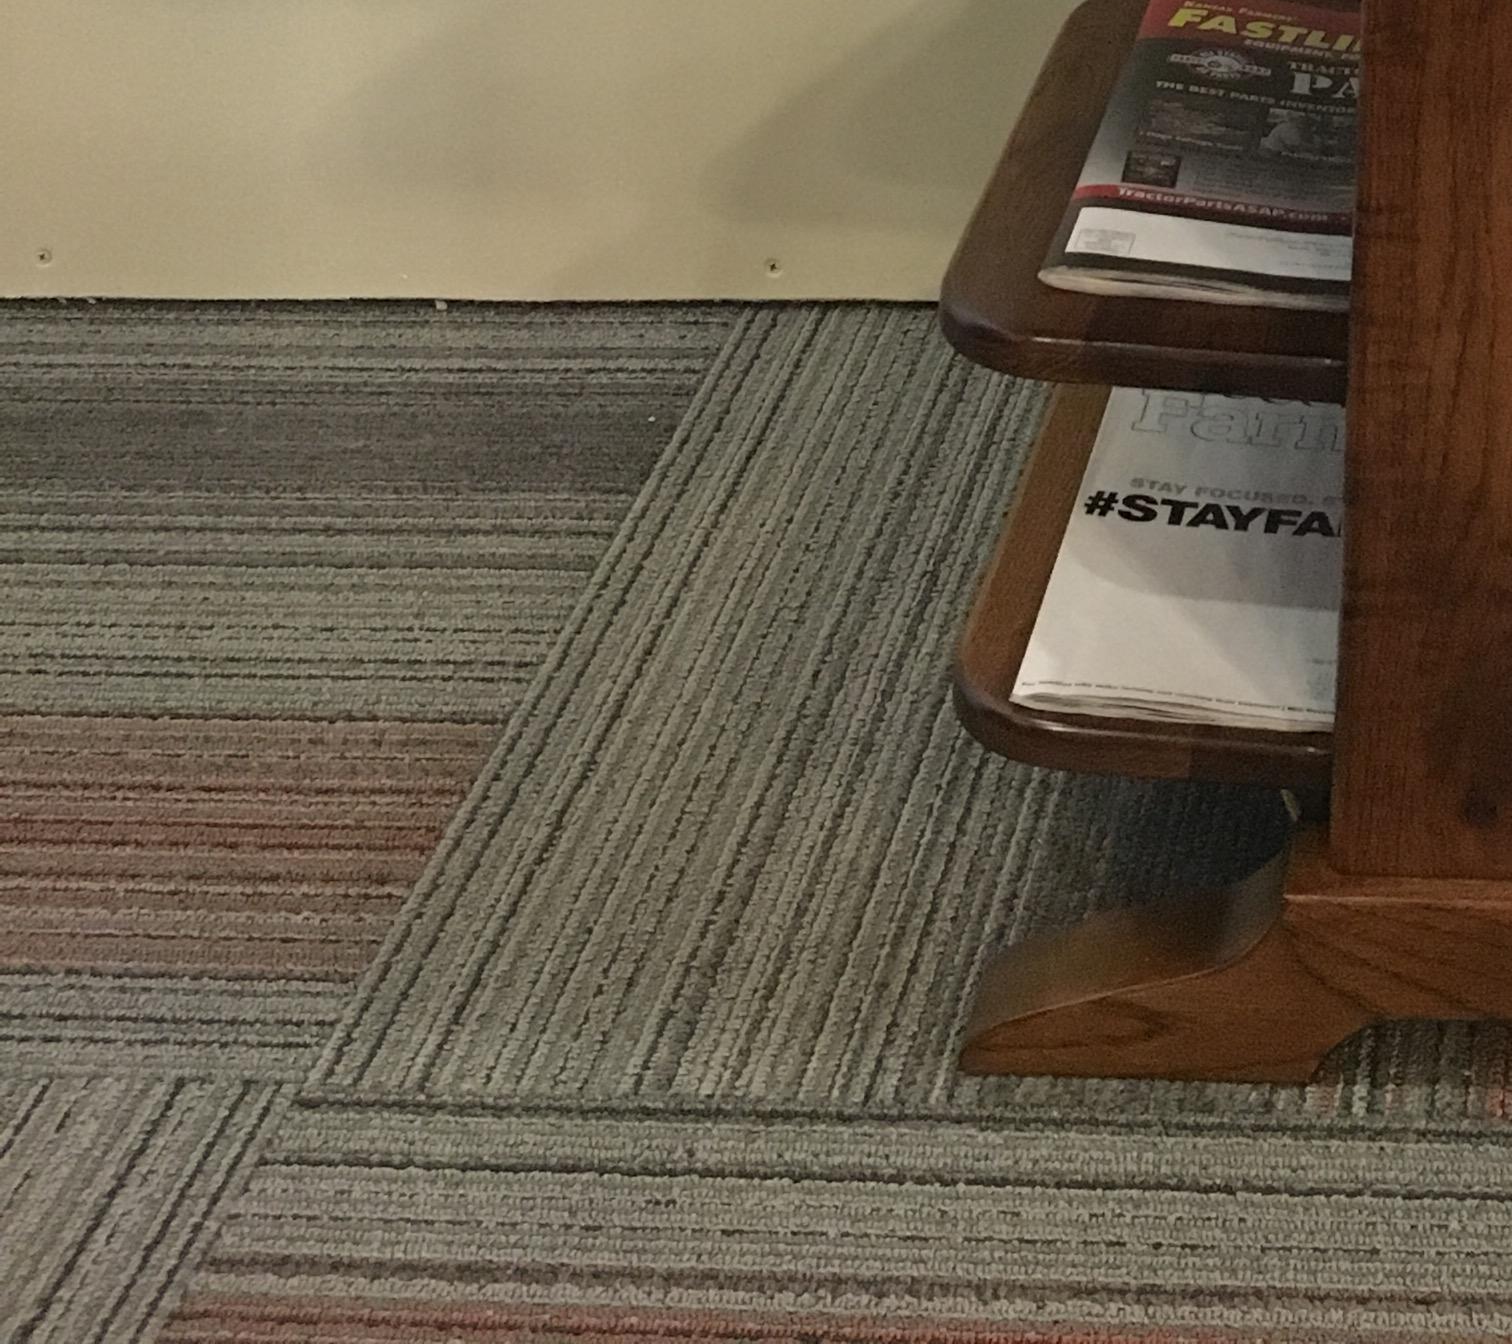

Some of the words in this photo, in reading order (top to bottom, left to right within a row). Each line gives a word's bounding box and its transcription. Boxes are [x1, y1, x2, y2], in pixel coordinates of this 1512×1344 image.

[1168, 8, 1361, 53] FASTLI
[1156, 80, 1184, 91] THE
[1188, 84, 1226, 97] BEST
[1229, 90, 1276, 105] PARTS
[1117, 186, 1329, 222] TractorPartsASAP.com
[1130, 477, 1188, 497] STAY
[1083, 490, 1342, 538] #STAYFA
